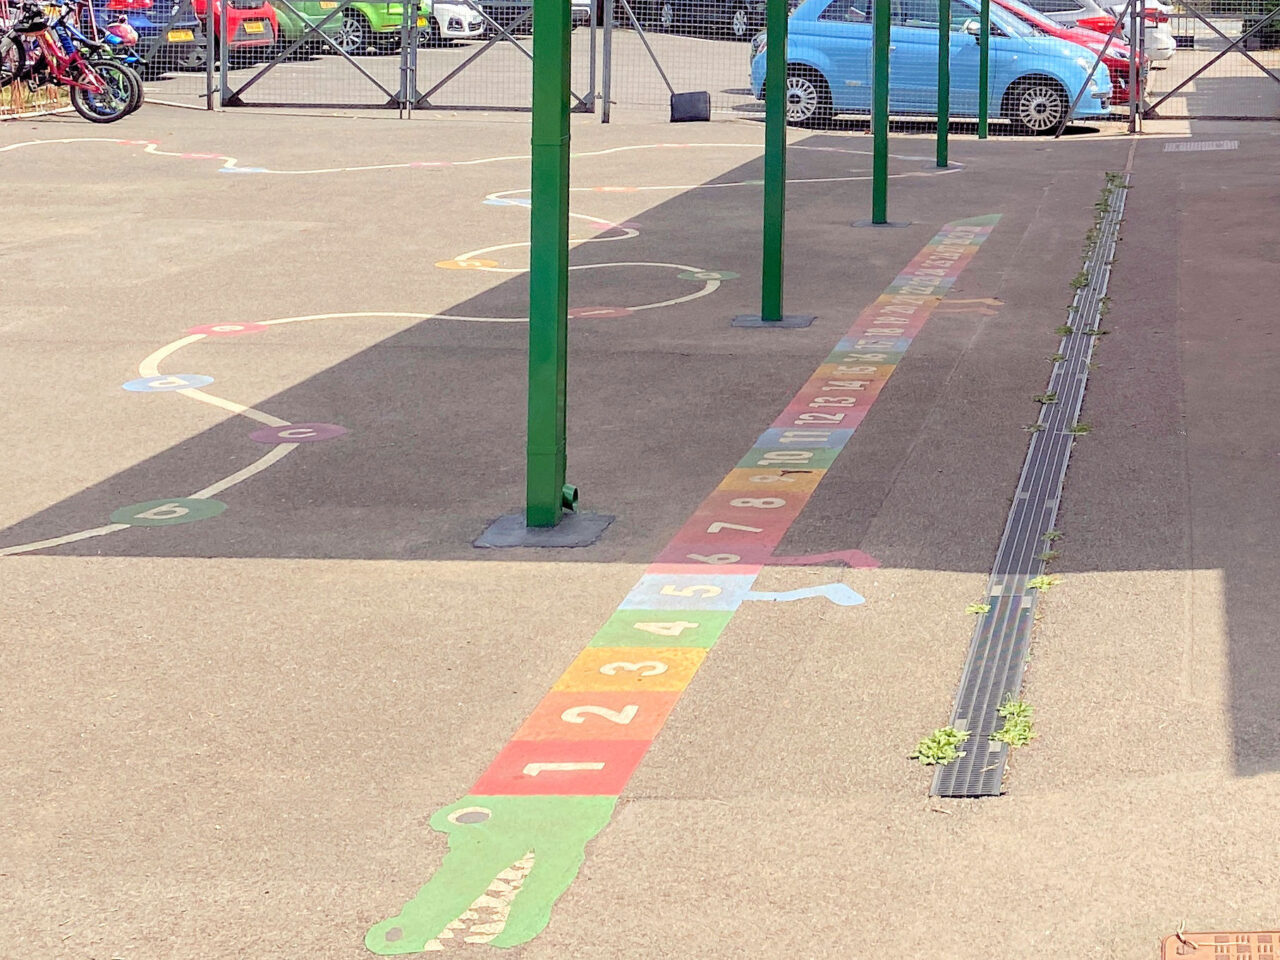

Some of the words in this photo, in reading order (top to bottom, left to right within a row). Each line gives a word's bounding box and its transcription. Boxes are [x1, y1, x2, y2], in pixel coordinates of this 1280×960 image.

[880, 305, 918, 314] 20
[874, 316, 909, 324] 19
[865, 327, 904, 336] 18
[855, 339, 895, 349] 17
[844, 352, 887, 362] 16
[833, 365, 877, 375] 15
[148, 377, 190, 388] d
[821, 380, 871, 390] 14
[808, 396, 857, 408] 13
[794, 412, 846, 425] 12
[277, 428, 318, 438] c
[778, 431, 832, 443] 11
[757, 450, 814, 465] 10
[748, 474, 796, 483] 9
[729, 497, 786, 509] 8
[133, 503, 189, 519] b
[706, 521, 763, 533] 7
[686, 553, 742, 565] 6
[659, 584, 723, 599] 5
[632, 620, 700, 636] 4
[599, 660, 669, 676] 3
[560, 704, 639, 725] 2
[522, 761, 605, 777] 1
